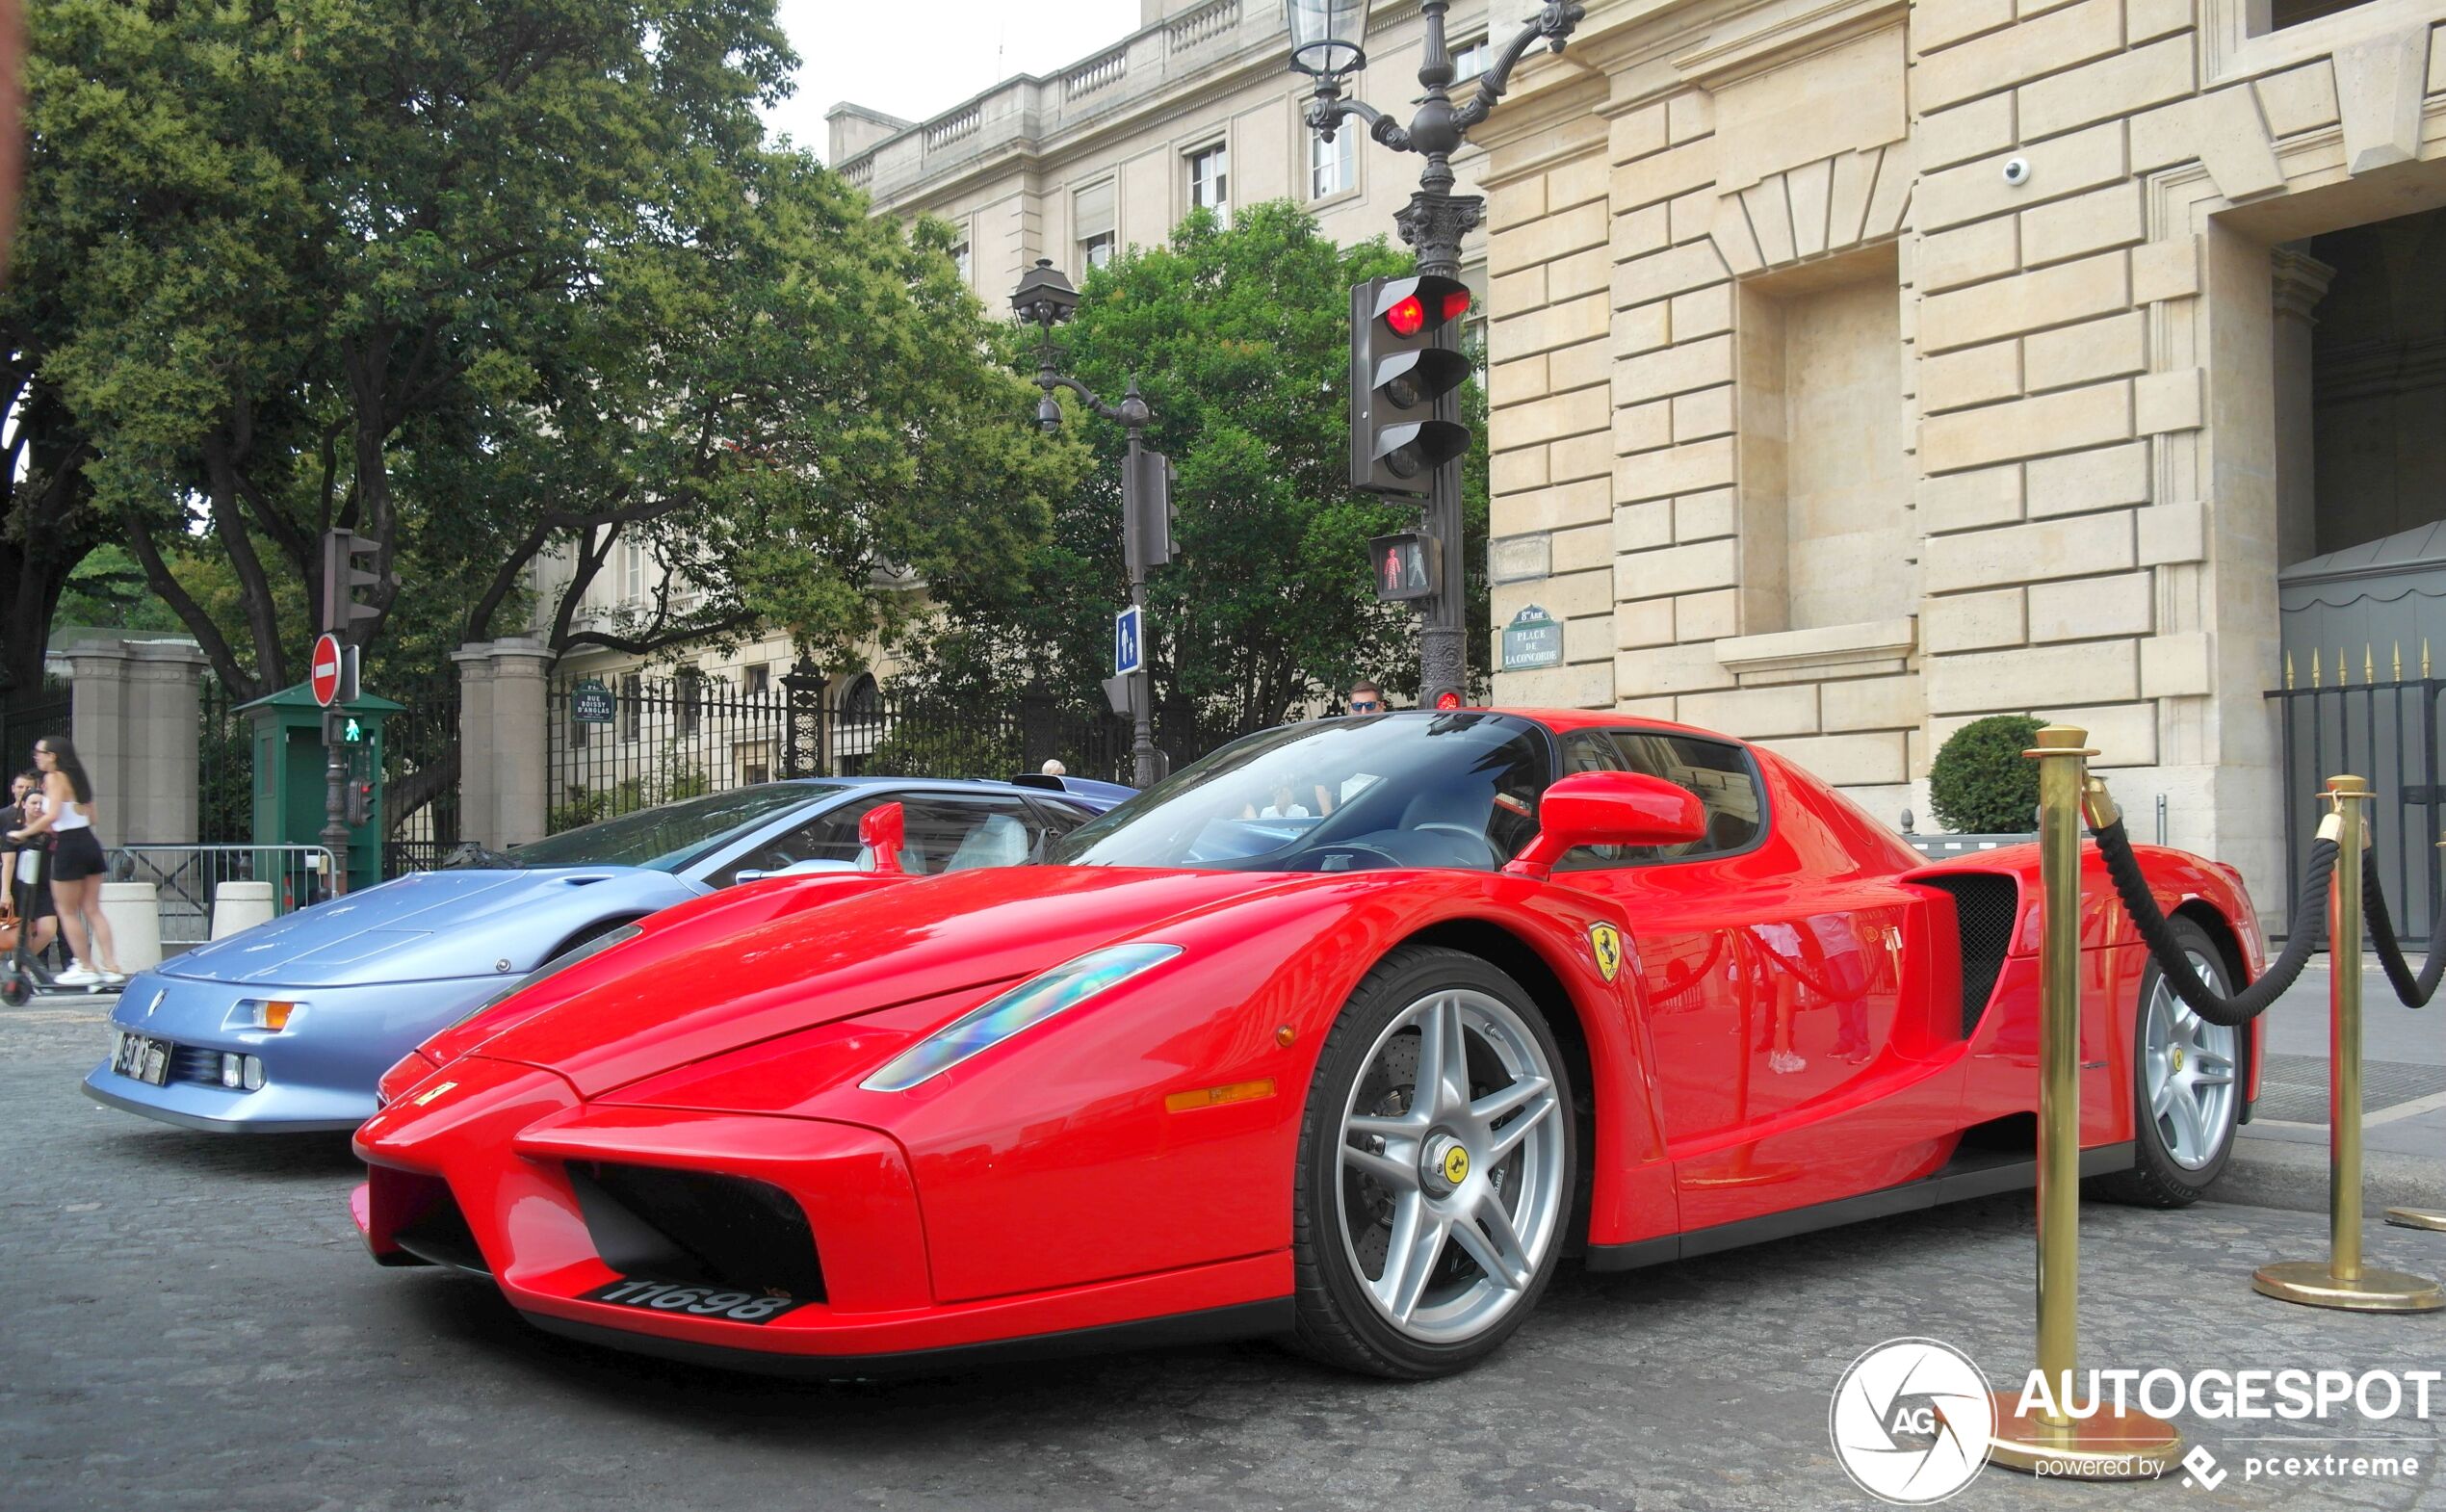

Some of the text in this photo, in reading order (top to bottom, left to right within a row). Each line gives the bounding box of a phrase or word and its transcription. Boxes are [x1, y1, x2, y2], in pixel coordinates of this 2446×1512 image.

[1517, 629, 1547, 641] PLACE
[1525, 642, 1537, 651] DE
[1505, 650, 1557, 665] LA CONCORDE
[601, 1280, 792, 1319] 11698
